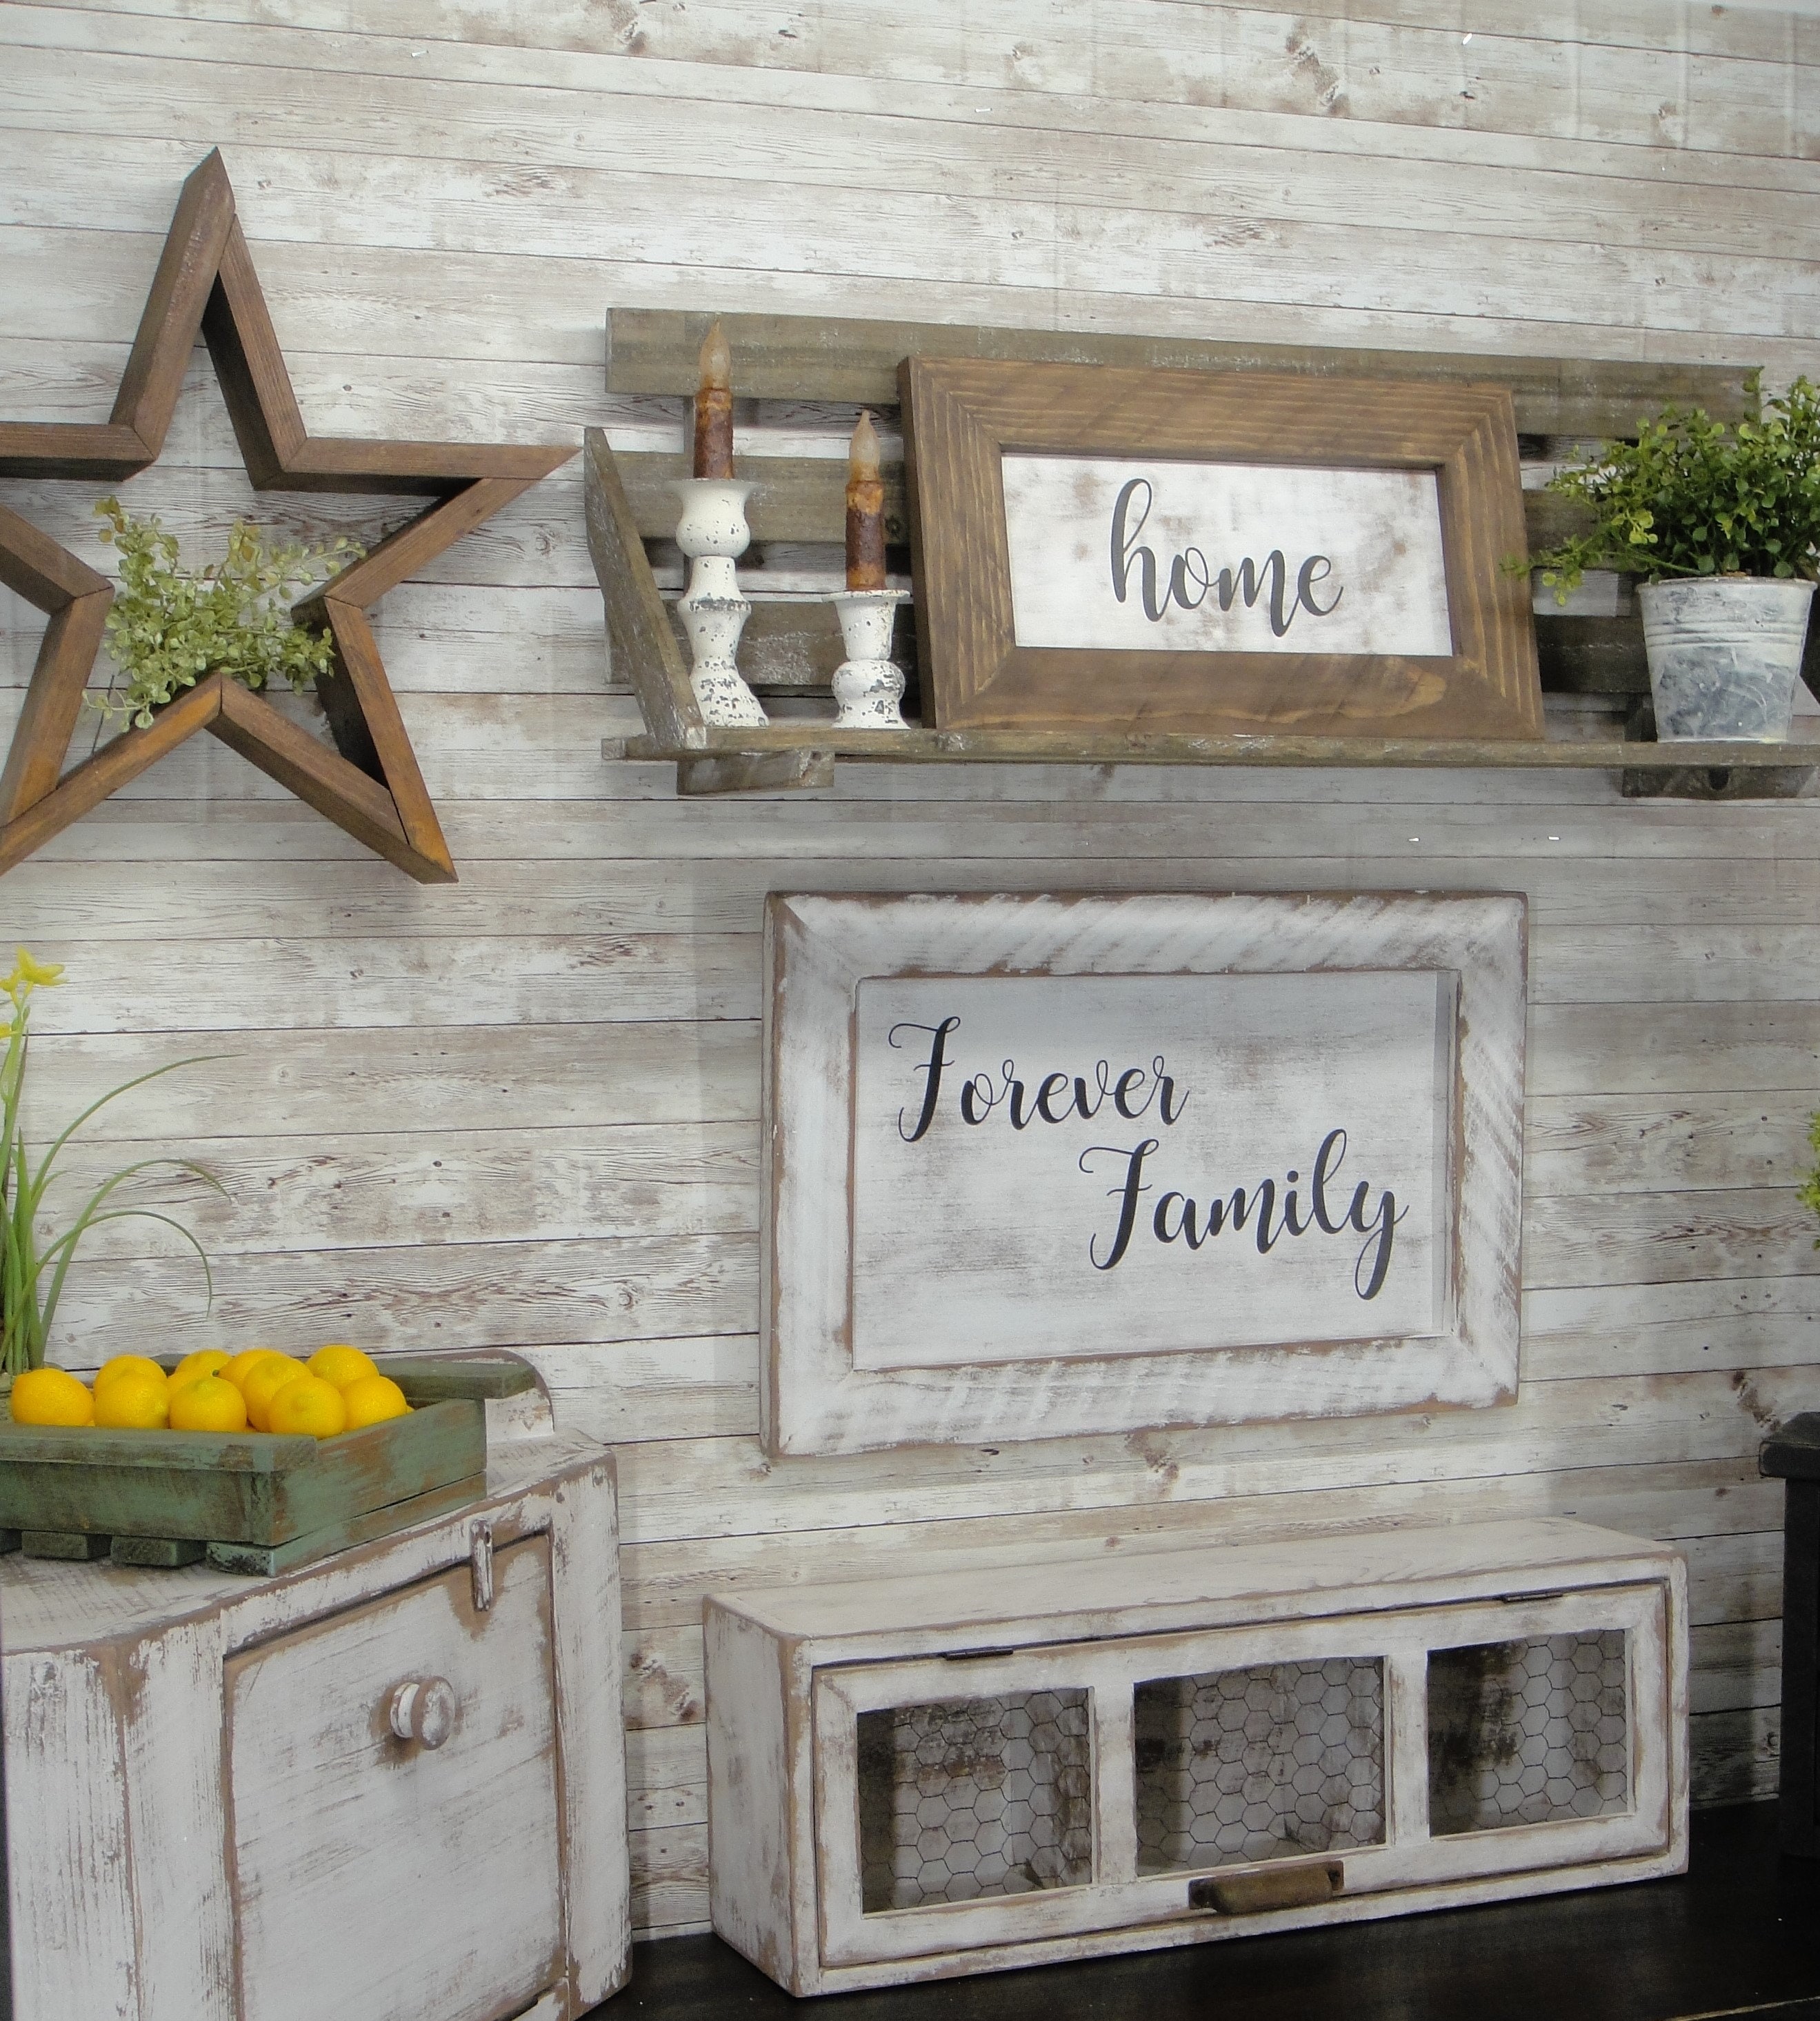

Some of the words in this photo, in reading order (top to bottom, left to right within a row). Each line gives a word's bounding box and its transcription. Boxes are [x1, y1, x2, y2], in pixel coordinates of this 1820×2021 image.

[1111, 478, 1343, 637] home
[888, 1016, 1190, 1143] Forever
[1079, 1128, 1409, 1301] Family
